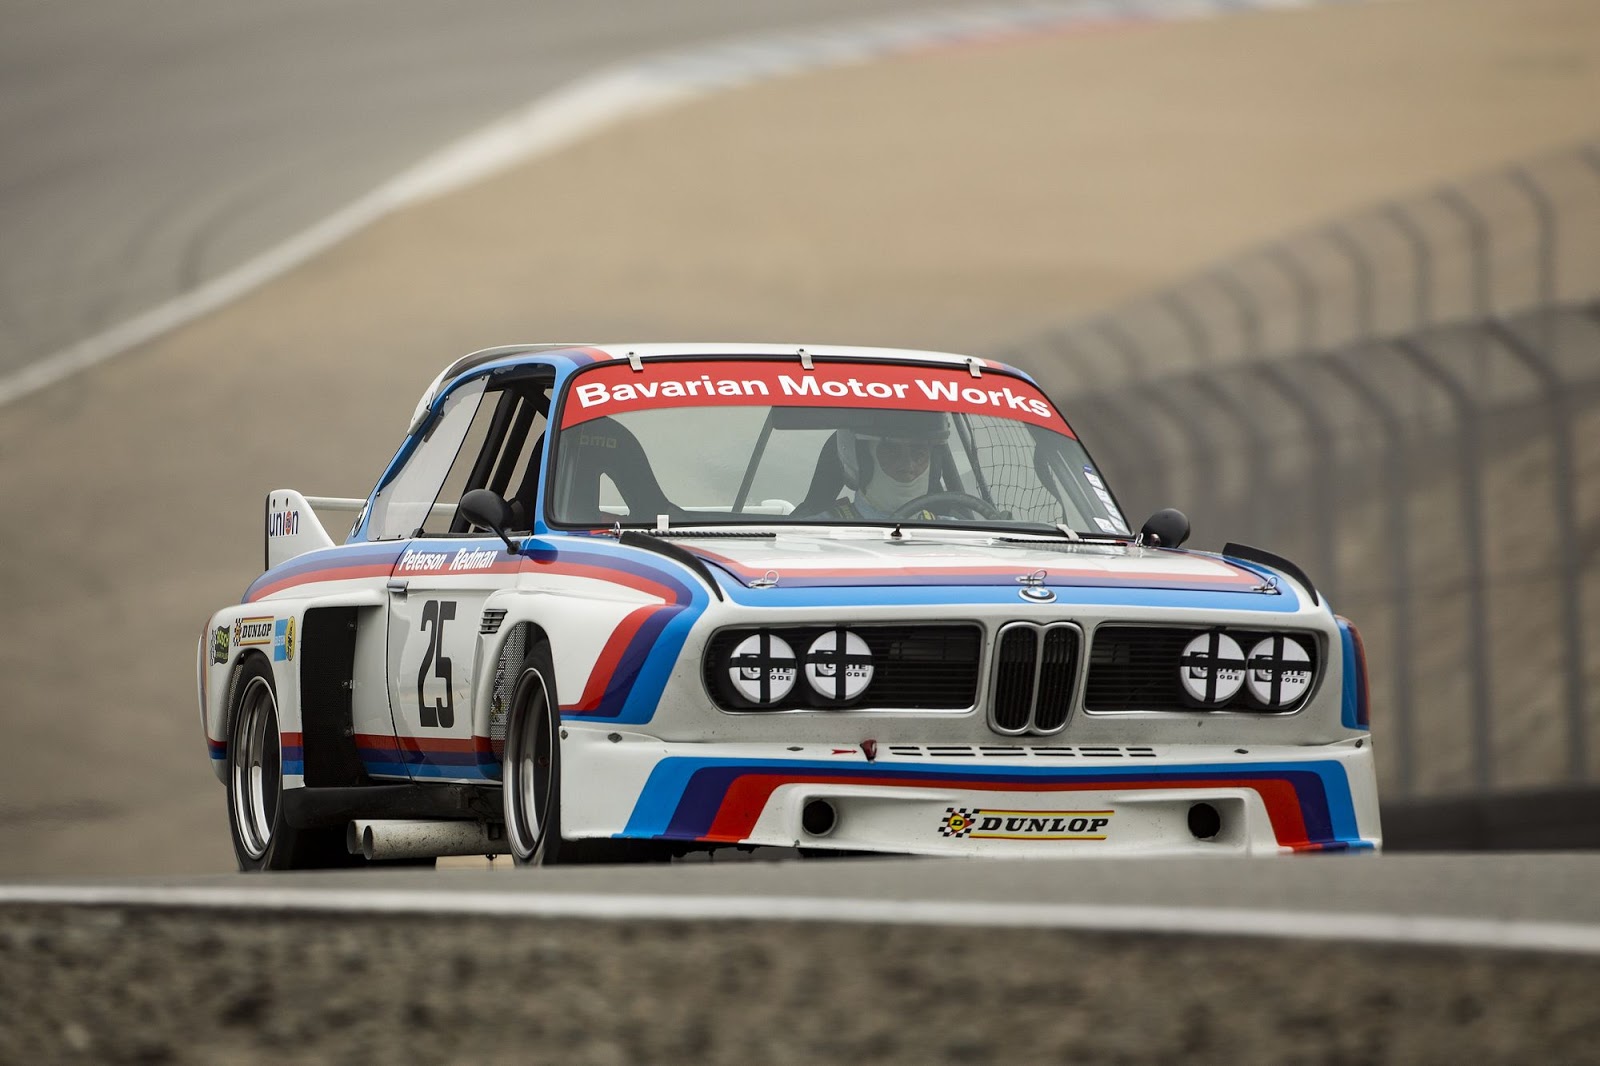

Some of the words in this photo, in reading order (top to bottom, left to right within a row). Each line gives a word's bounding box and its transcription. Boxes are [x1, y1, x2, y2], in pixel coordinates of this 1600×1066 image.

[576, 375, 769, 408] Bavarian
[778, 375, 909, 399] Motor
[915, 379, 1051, 418] Works
[398, 549, 448, 571] Peterson
[448, 546, 499, 571] Redman
[241, 623, 273, 639] DUNLOP
[417, 600, 457, 728] 25
[977, 817, 1109, 832] DUNLOP
